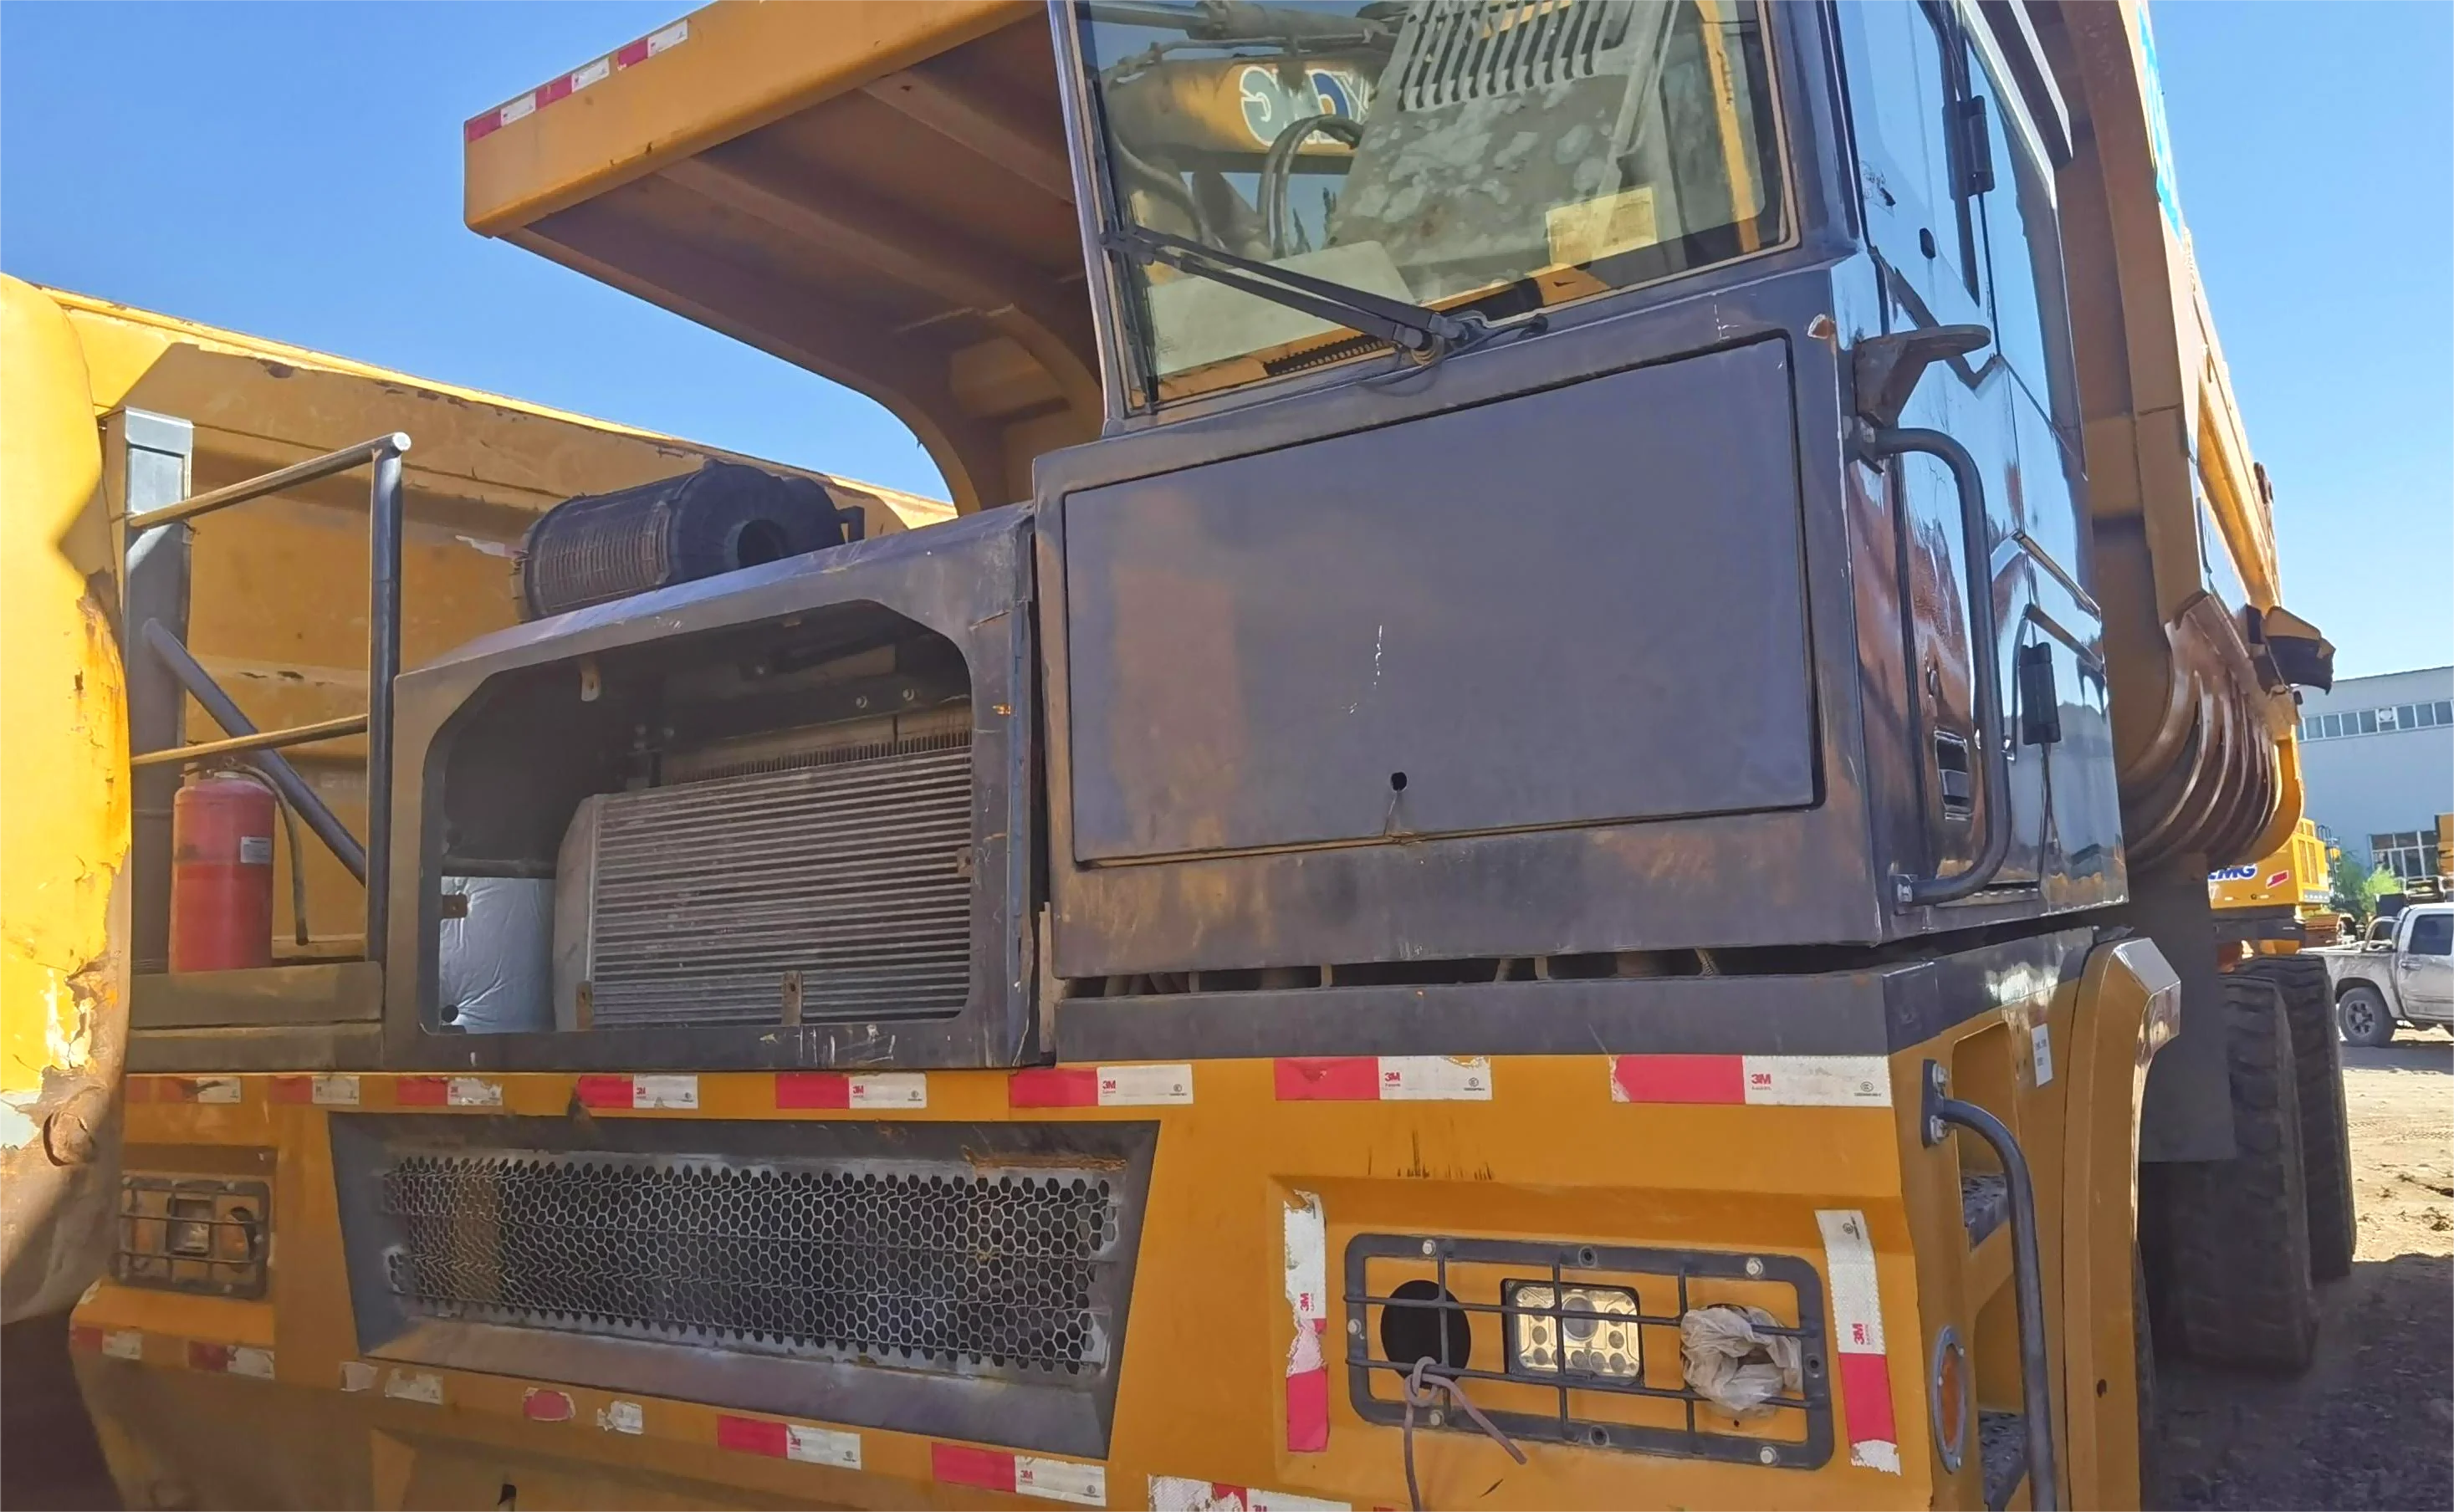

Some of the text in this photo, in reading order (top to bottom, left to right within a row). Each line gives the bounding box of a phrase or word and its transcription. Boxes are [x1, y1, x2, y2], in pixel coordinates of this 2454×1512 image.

[1385, 1072, 1400, 1081] 3M
[1751, 1074, 1771, 1084] 3M
[1102, 1080, 1116, 1090] 3M
[1300, 1293, 1309, 1311] 3M
[1852, 1324, 1864, 1345] 3M
[1020, 1470, 1033, 1480] 3M
